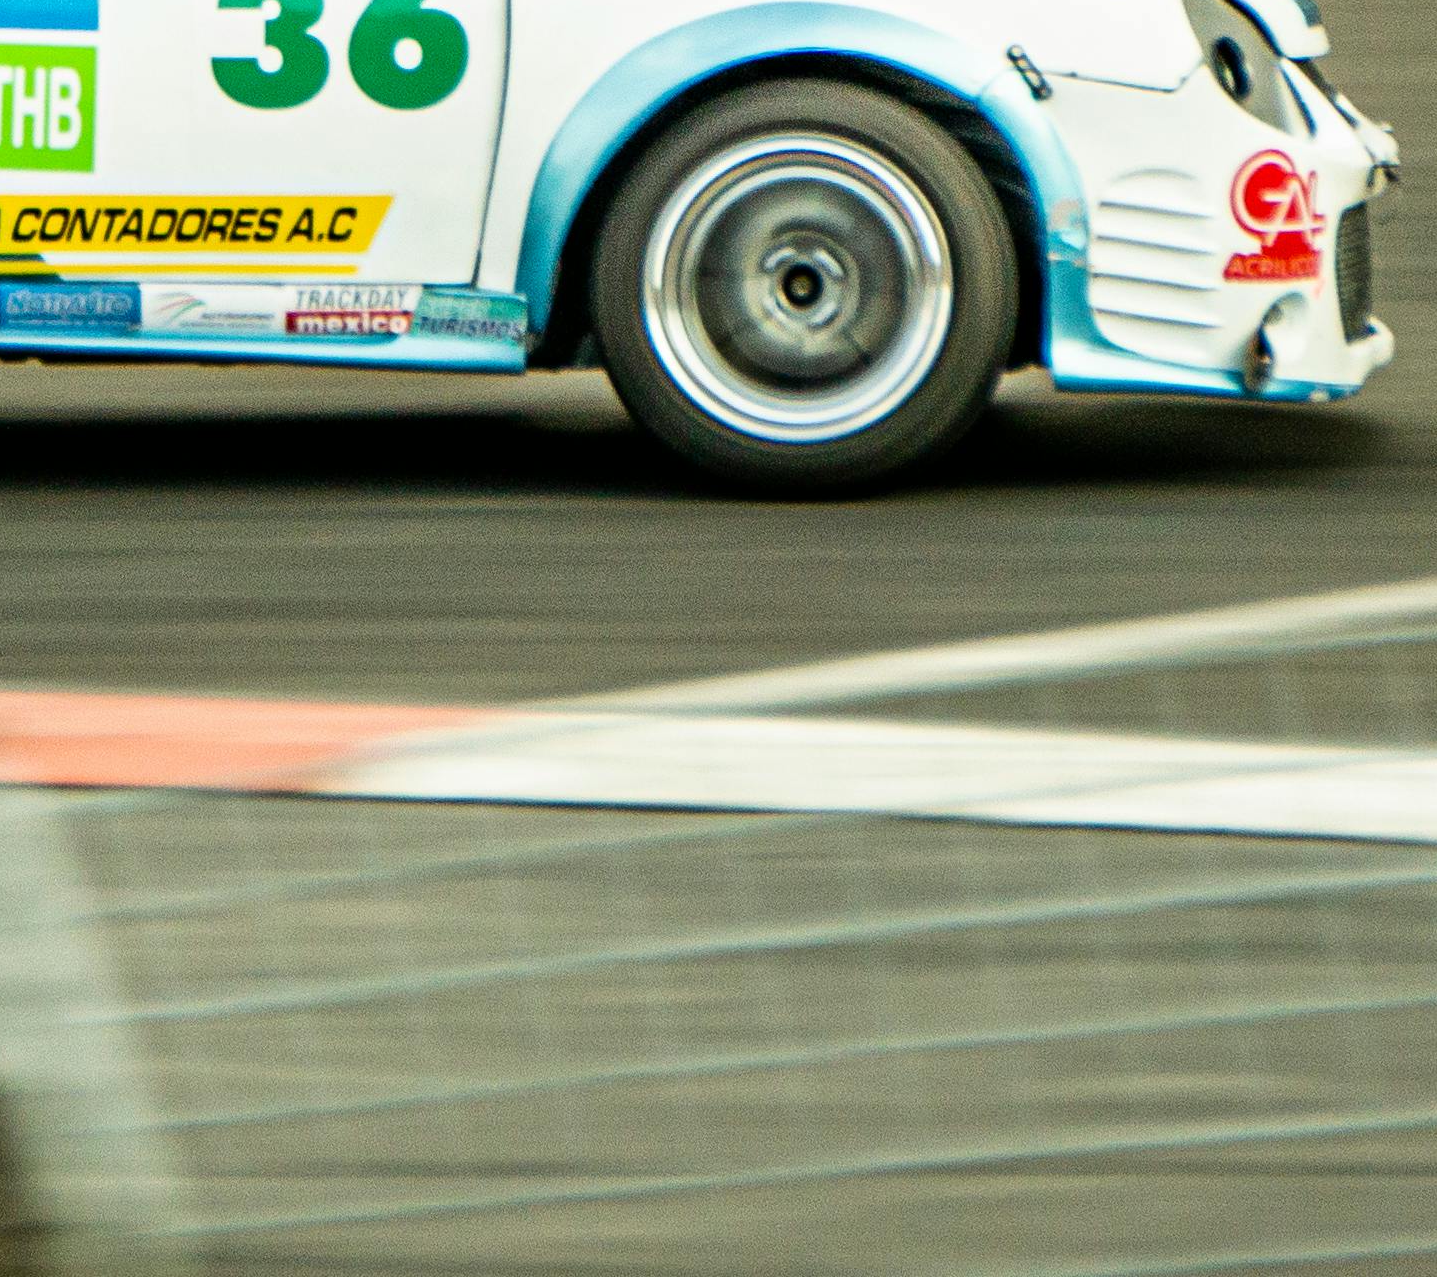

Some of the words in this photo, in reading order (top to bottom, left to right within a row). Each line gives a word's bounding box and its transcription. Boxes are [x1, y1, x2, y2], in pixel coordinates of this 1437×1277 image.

[11, 208, 280, 243] CONTADORES
[286, 208, 358, 242] A.C
[295, 289, 408, 311] TRACKDAY
[297, 312, 408, 333] mexico
